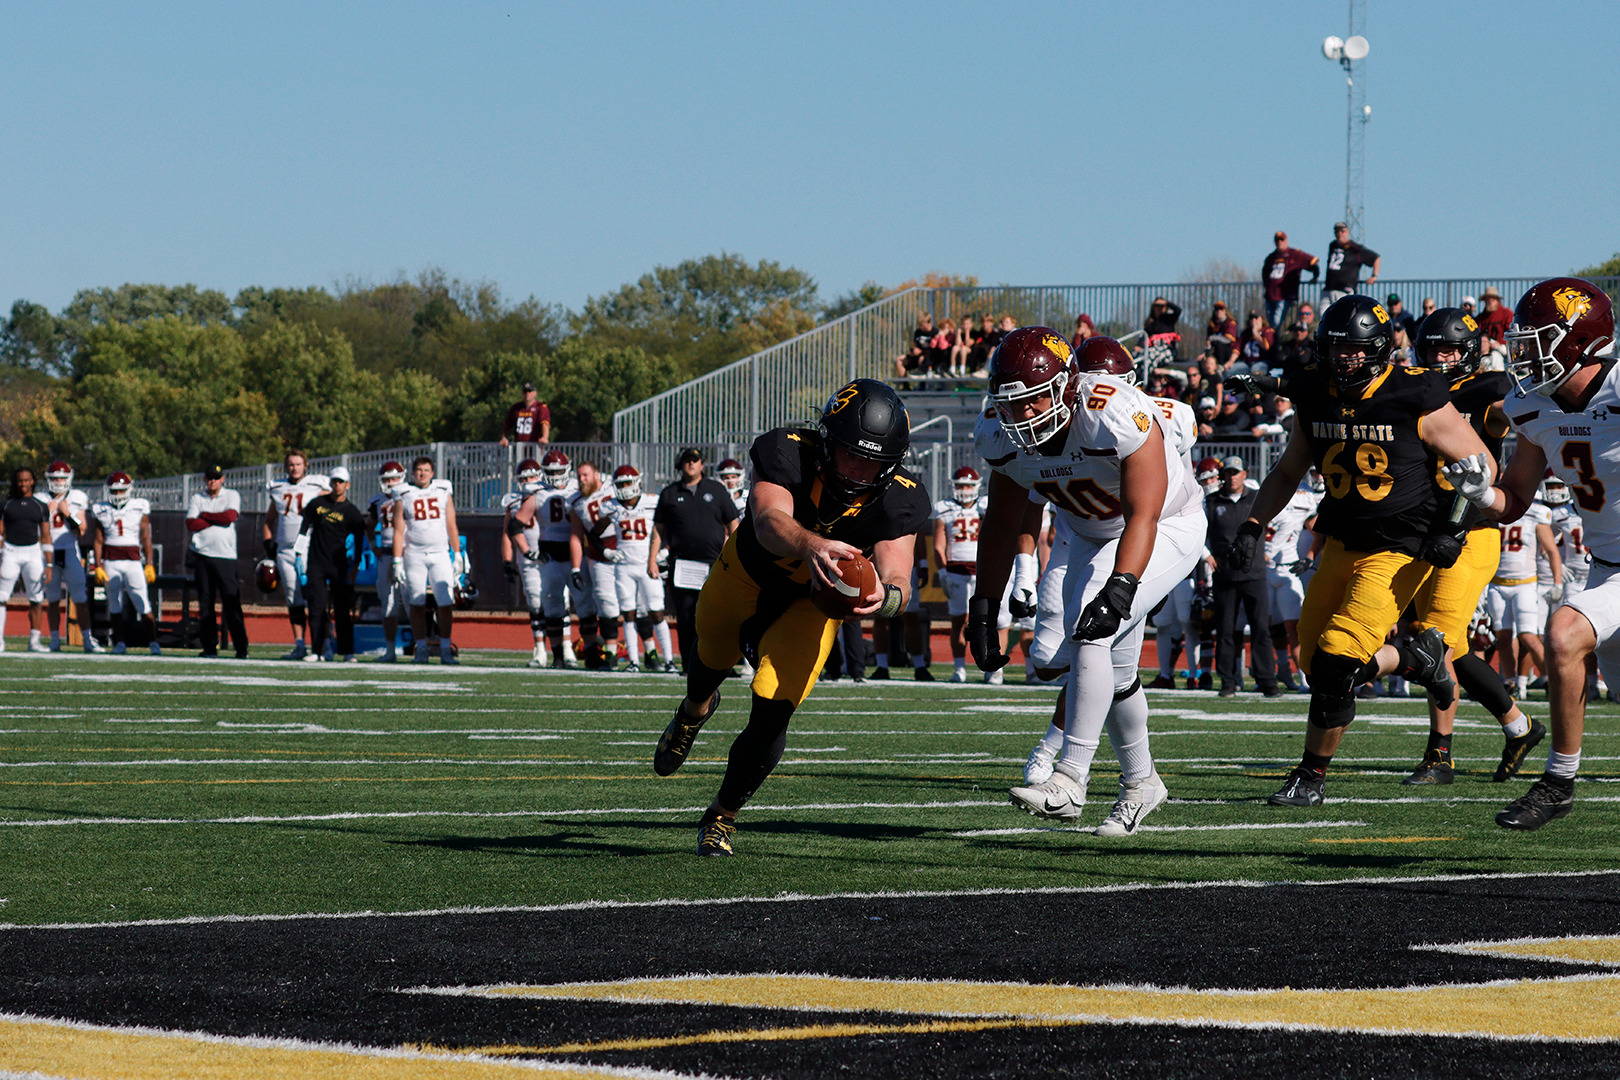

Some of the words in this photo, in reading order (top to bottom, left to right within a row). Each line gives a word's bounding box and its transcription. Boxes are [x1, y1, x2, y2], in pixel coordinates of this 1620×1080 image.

[1087, 383, 1118, 411] 90
[1312, 422, 1347, 440] WAYNE
[1352, 425, 1394, 441] STATE
[1558, 426, 1591, 436] BULLDOGS
[858, 440, 882, 452] Riddell
[1040, 466, 1073, 478] BULLDOGS
[1322, 442, 1394, 501] 68
[1560, 441, 1606, 513] 3
[283, 493, 304, 516] 71
[413, 497, 440, 521] 85
[115, 519, 124, 537] 1
[619, 518, 648, 541] 20
